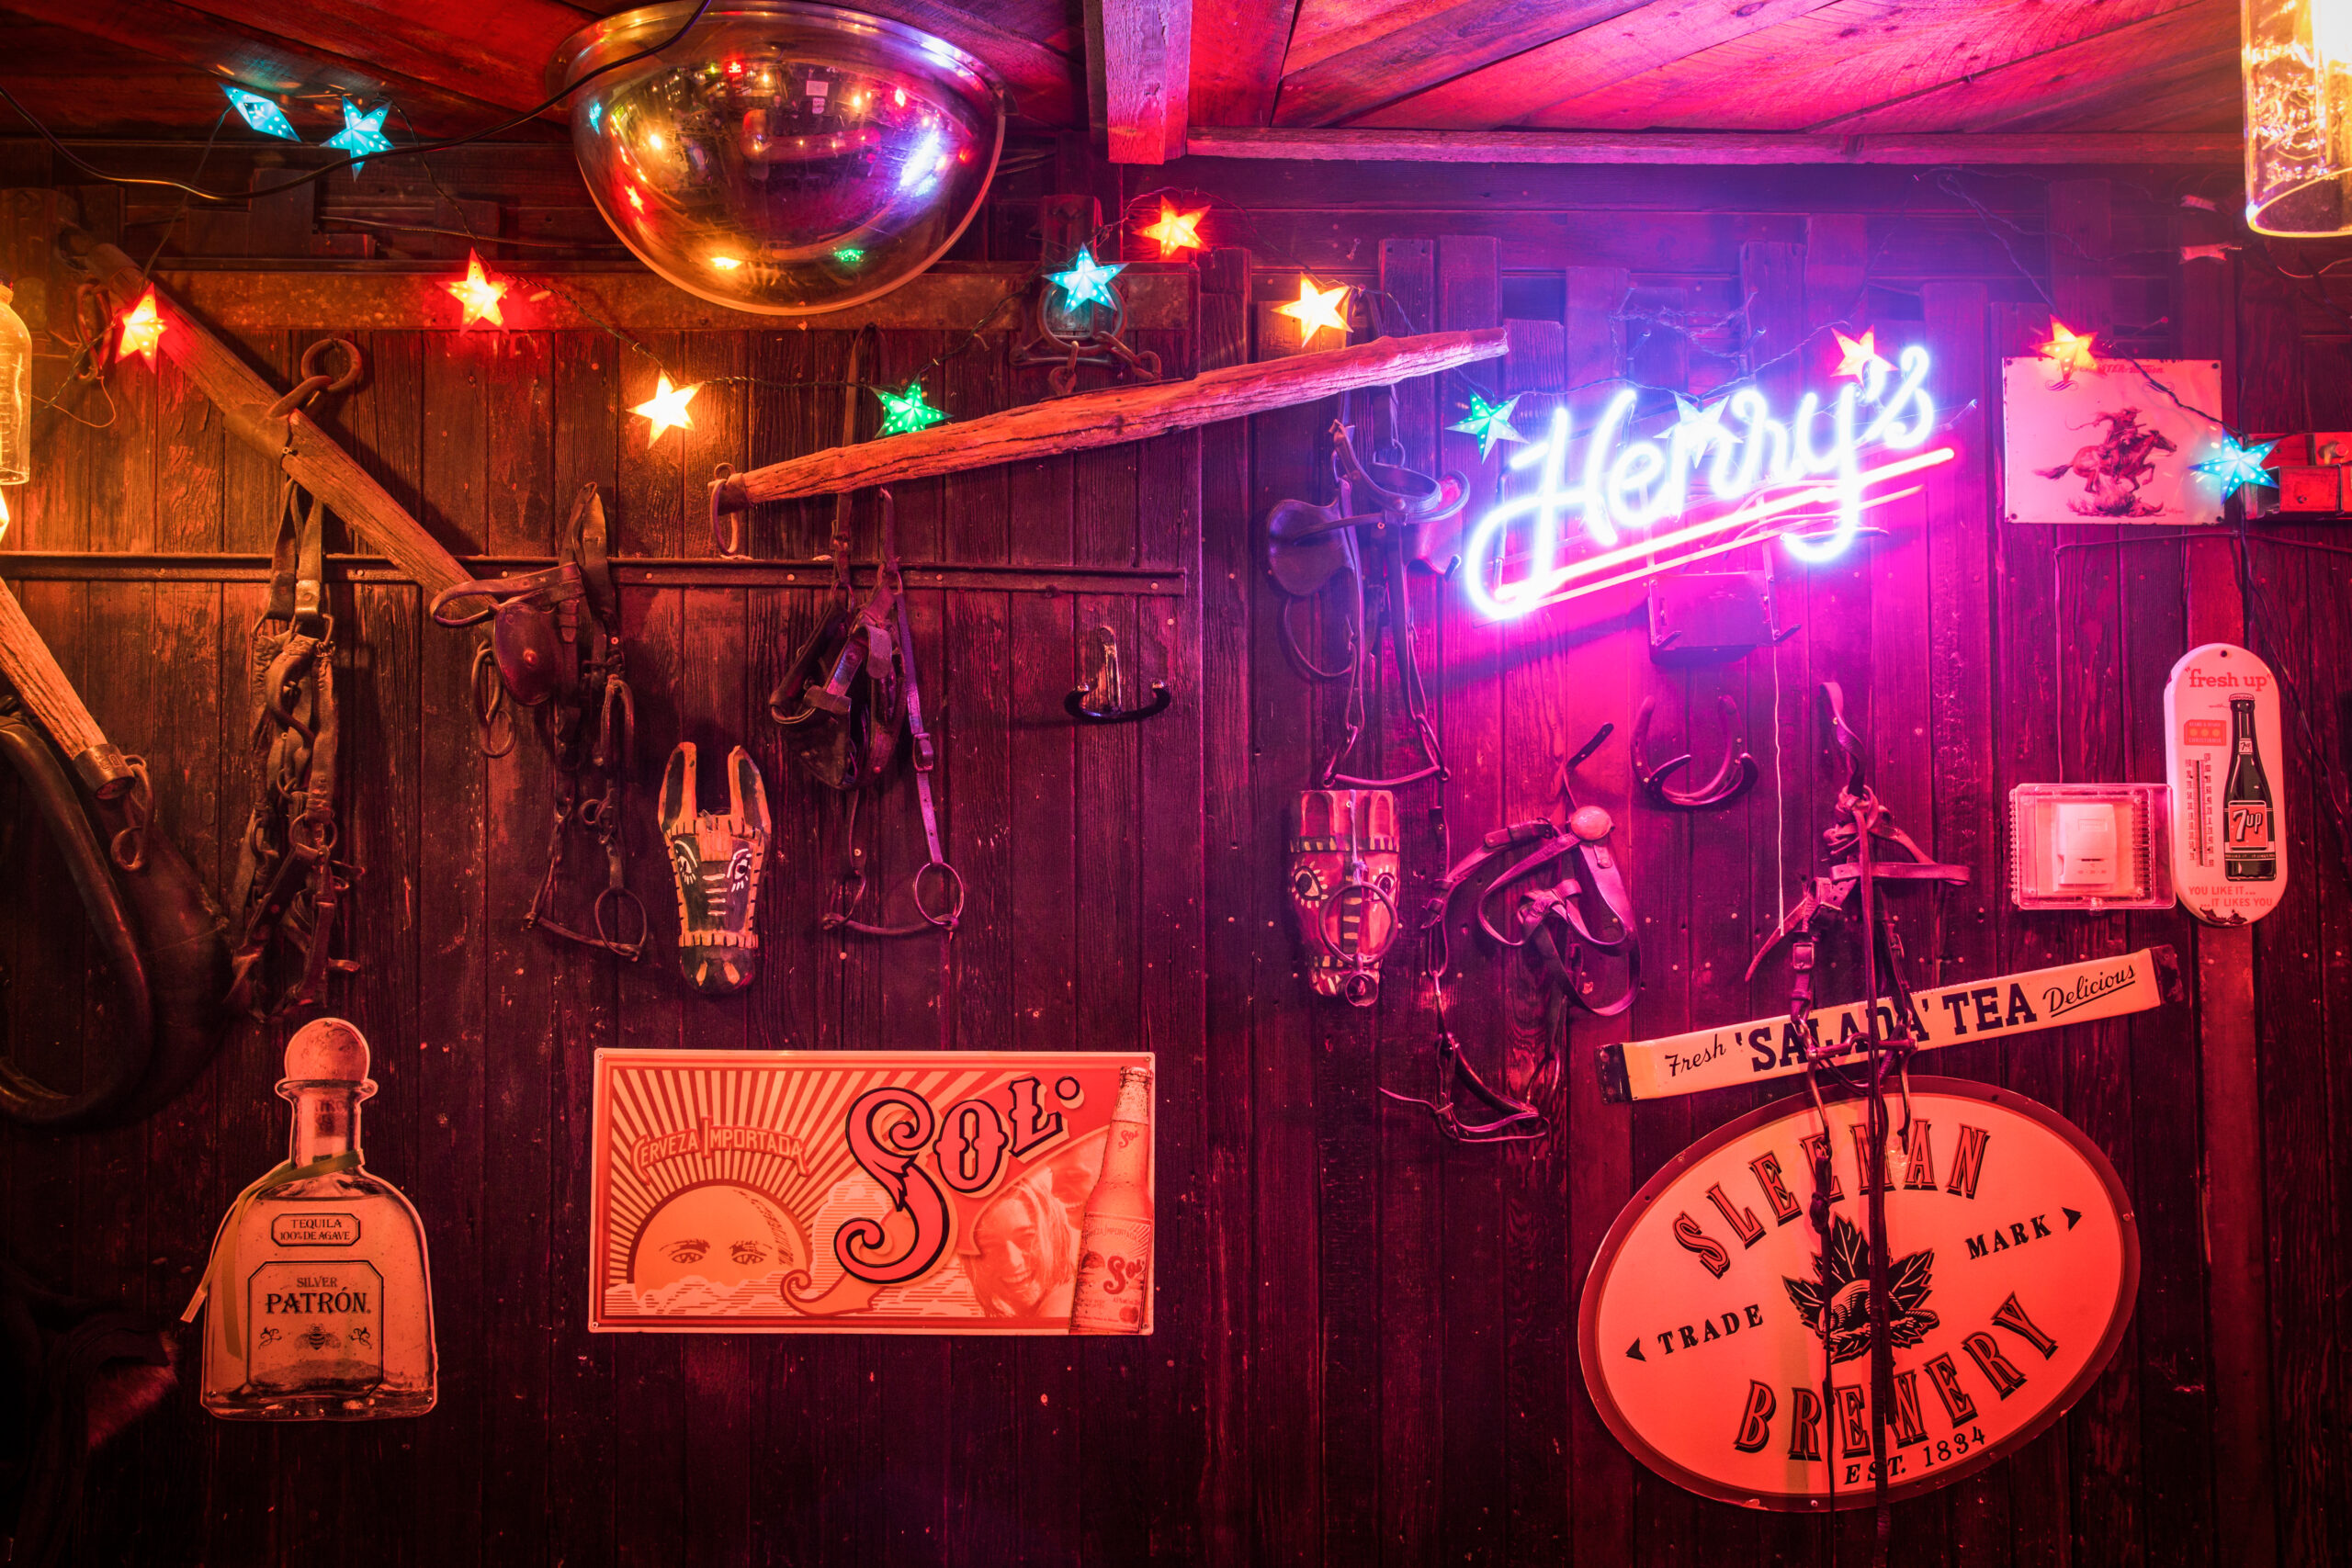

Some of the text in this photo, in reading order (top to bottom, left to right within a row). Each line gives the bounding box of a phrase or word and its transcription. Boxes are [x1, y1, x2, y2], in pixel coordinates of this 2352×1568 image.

[1468, 344, 1935, 617] Henry's
[2188, 886, 2208, 896] YOU
[2211, 886, 2233, 896] LIKE
[2223, 897, 2250, 908] LIKES
[2254, 897, 2273, 908] YOU
[1664, 1033, 1727, 1077] Fresh
[1942, 982, 2038, 1036] TEA
[2042, 963, 2137, 1015] Delicious
[631, 1114, 810, 1186] CERVEZA IMPORTADA
[290, 1218, 343, 1230] TEQUILA
[318, 1231, 351, 1241] AGAVE
[1965, 1213, 2052, 1259] MARK
[296, 1275, 338, 1288] SILVER
[1657, 1303, 1764, 1355] TRADE
[1733, 1290, 2058, 1462] BREWERY
[1923, 1426, 1985, 1468] 1834
